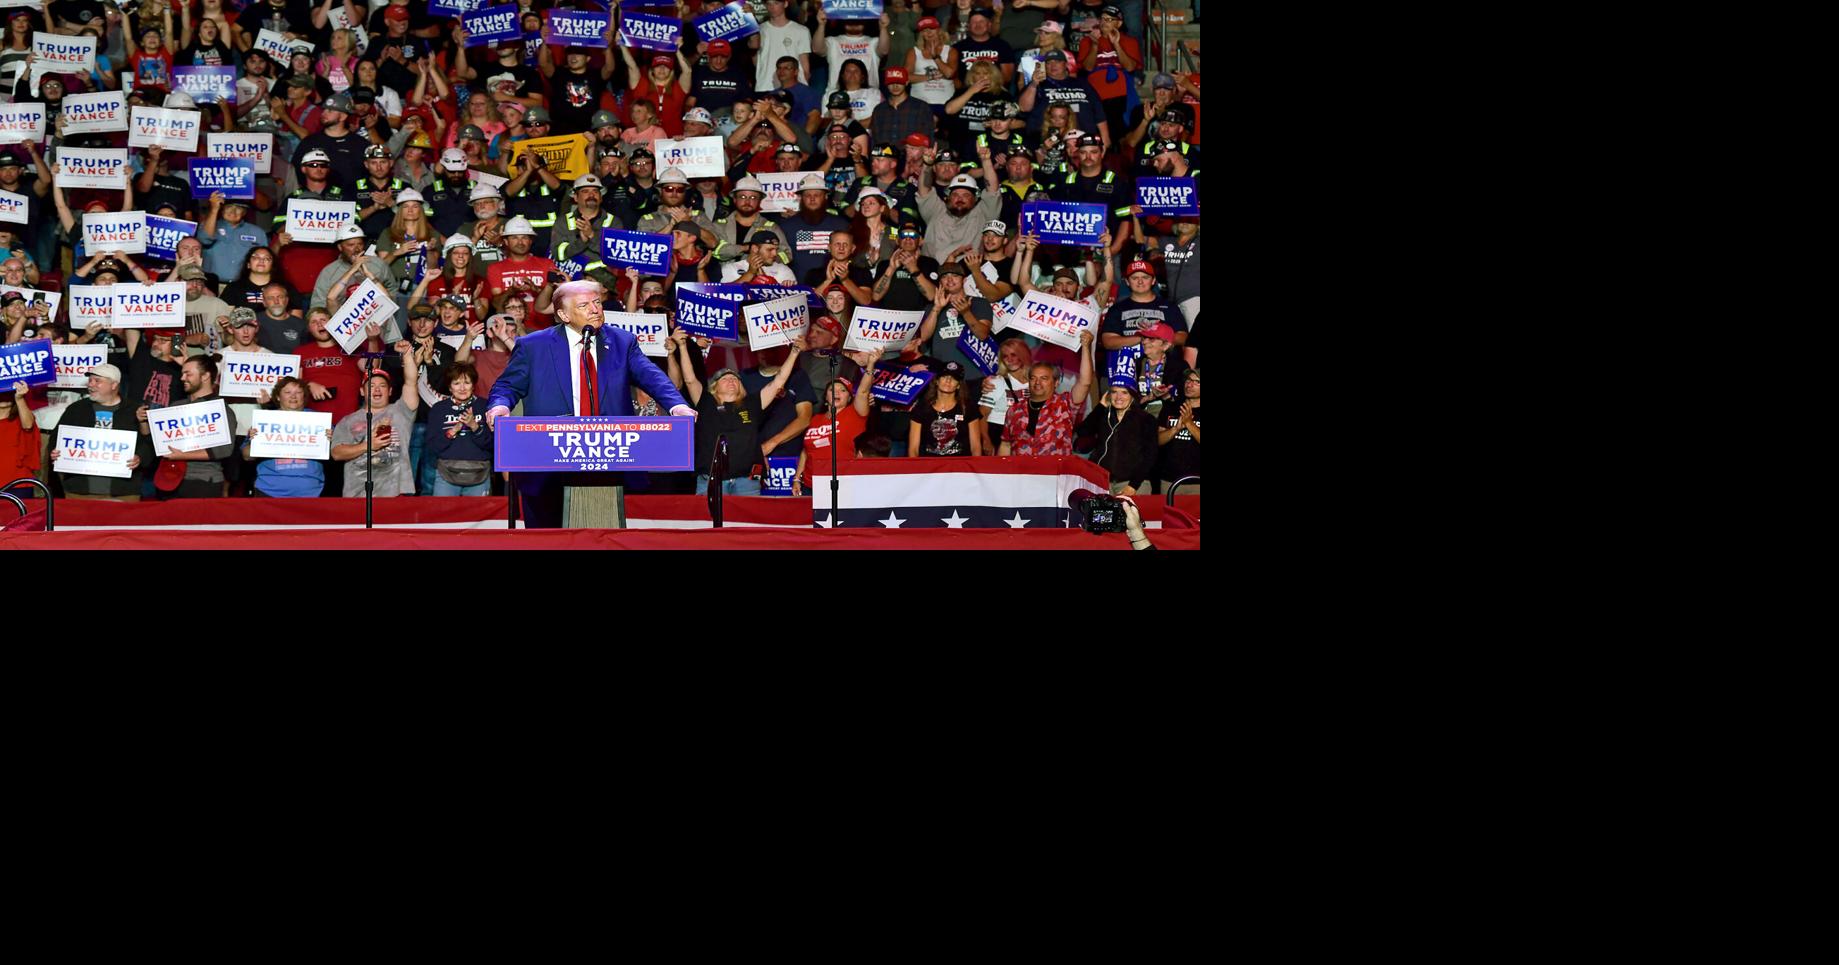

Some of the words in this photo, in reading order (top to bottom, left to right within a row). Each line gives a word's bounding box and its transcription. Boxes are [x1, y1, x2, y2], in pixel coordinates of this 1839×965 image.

[439, 0, 479, 9] VANCE
[831, 0, 873, 8] VANCE
[465, 13, 515, 27] TRUMP
[552, 17, 607, 28] TRUMP
[624, 18, 678, 33] TRUMP
[698, 12, 742, 33] TRUM
[470, 22, 511, 34] VANCE
[557, 26, 600, 36] VANCE
[707, 19, 747, 37] VANCE
[629, 28, 670, 40] VANCE
[37, 42, 91, 54] TRUMP
[43, 51, 84, 62] VANCE
[176, 74, 232, 84] TRUMP
[182, 83, 228, 92] VANCE
[65, 101, 120, 114] TRUMP
[961, 106, 991, 117] TRUM
[0, 112, 41, 122] RUMP
[71, 112, 114, 121] VANCE
[0, 121, 36, 130] ANCE
[136, 116, 194, 129] TRUMP
[141, 126, 187, 137] VANCE
[213, 143, 269, 153] TRUMP
[660, 147, 718, 158] TRUMP
[62, 157, 122, 168] TRUMP
[667, 156, 713, 166] VANCE
[68, 167, 116, 175] VANCE
[193, 167, 250, 177] TRUMP
[199, 176, 244, 185] VANCE
[1139, 187, 1193, 197] TRUMP
[1143, 196, 1188, 204] VANCE
[292, 209, 350, 220] TRUMP
[1038, 210, 1103, 224] TRUMP
[86, 222, 141, 233] TRUMP
[1044, 221, 1094, 232] VANCE
[92, 232, 135, 241] VANCE
[145, 235, 177, 249] ANCE
[605, 237, 668, 254] TRUMP
[610, 248, 659, 262] VANCE
[1131, 262, 1146, 270] USA
[74, 297, 112, 307] TRU
[118, 294, 180, 305] TRUMP
[125, 304, 173, 313] VANCE
[334, 289, 376, 335] TRUMP
[678, 298, 733, 318] TRUMP
[1027, 300, 1088, 327] TRUMP
[345, 301, 379, 336] VANCE
[679, 311, 726, 327] VANCE
[752, 304, 806, 327] TRUMP
[761, 316, 805, 334] VANCE
[858, 318, 916, 331] TRUMP
[1028, 311, 1077, 335] VANCE
[862, 329, 906, 340] VANCE
[53, 356, 102, 366] RUMP
[0, 362, 44, 376] ANCE
[228, 362, 293, 376] TRUMP
[155, 412, 222, 431] TRUMP
[546, 423, 621, 431] PENNSYLVANIA
[164, 423, 217, 439] VANCE
[258, 422, 325, 435] TRUMP
[265, 433, 317, 444] VANCE
[548, 432, 641, 447] TRUMP
[63, 437, 130, 452] TRUMP
[69, 449, 121, 461] VANCE
[559, 446, 630, 458] VANCE
[580, 463, 609, 471] 2024
